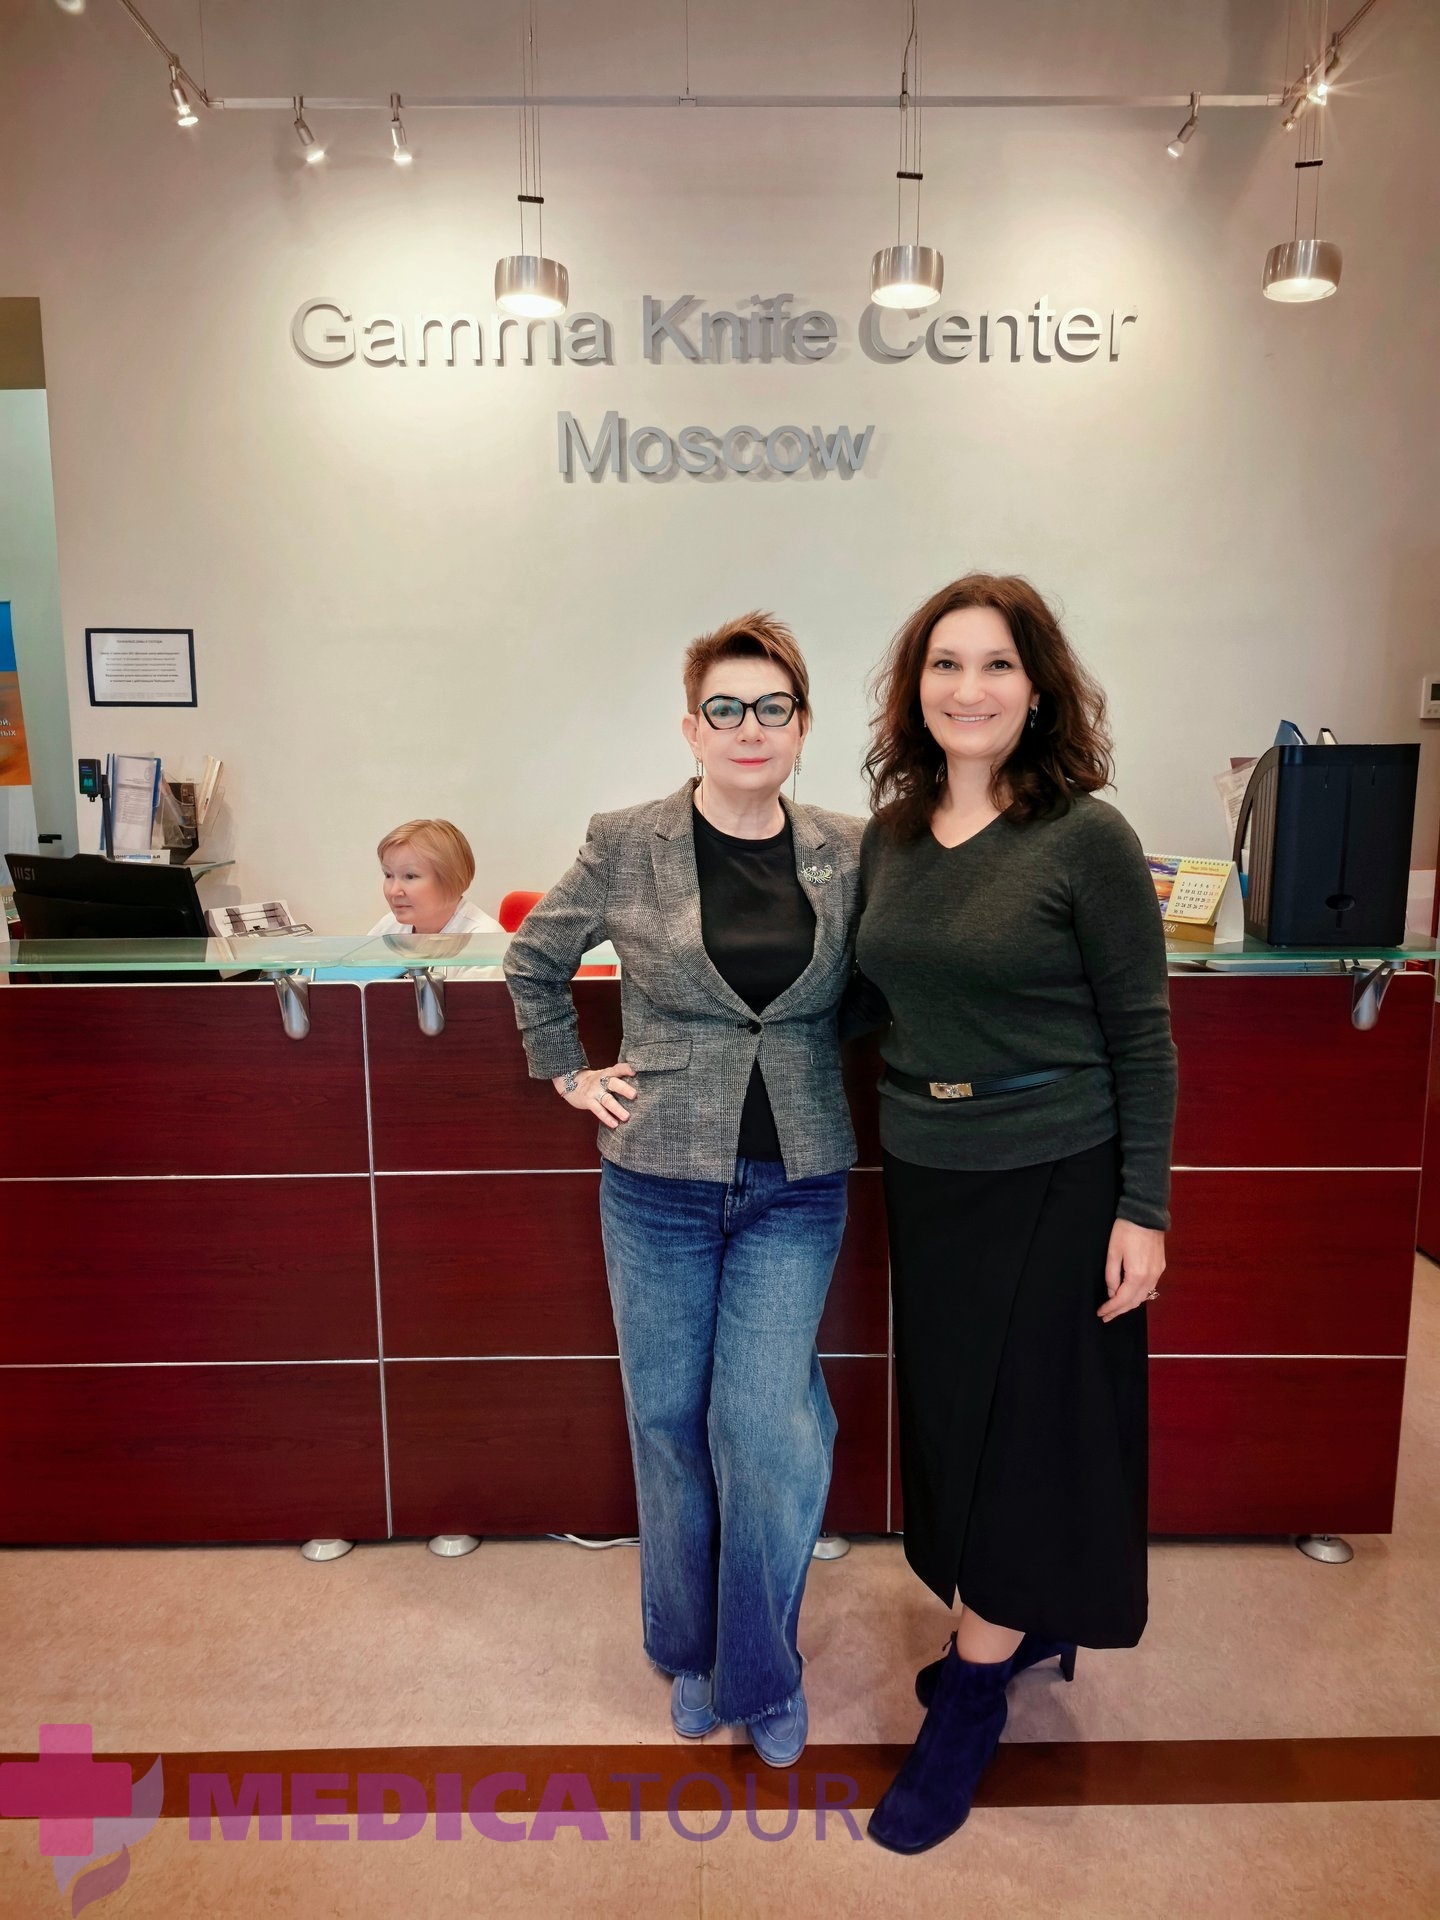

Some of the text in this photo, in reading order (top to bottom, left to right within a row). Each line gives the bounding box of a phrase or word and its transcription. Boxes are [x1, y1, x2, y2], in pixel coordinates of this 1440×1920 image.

[293, 294, 1138, 362] Gamma Knife Center
[557, 410, 876, 473] Moscow
